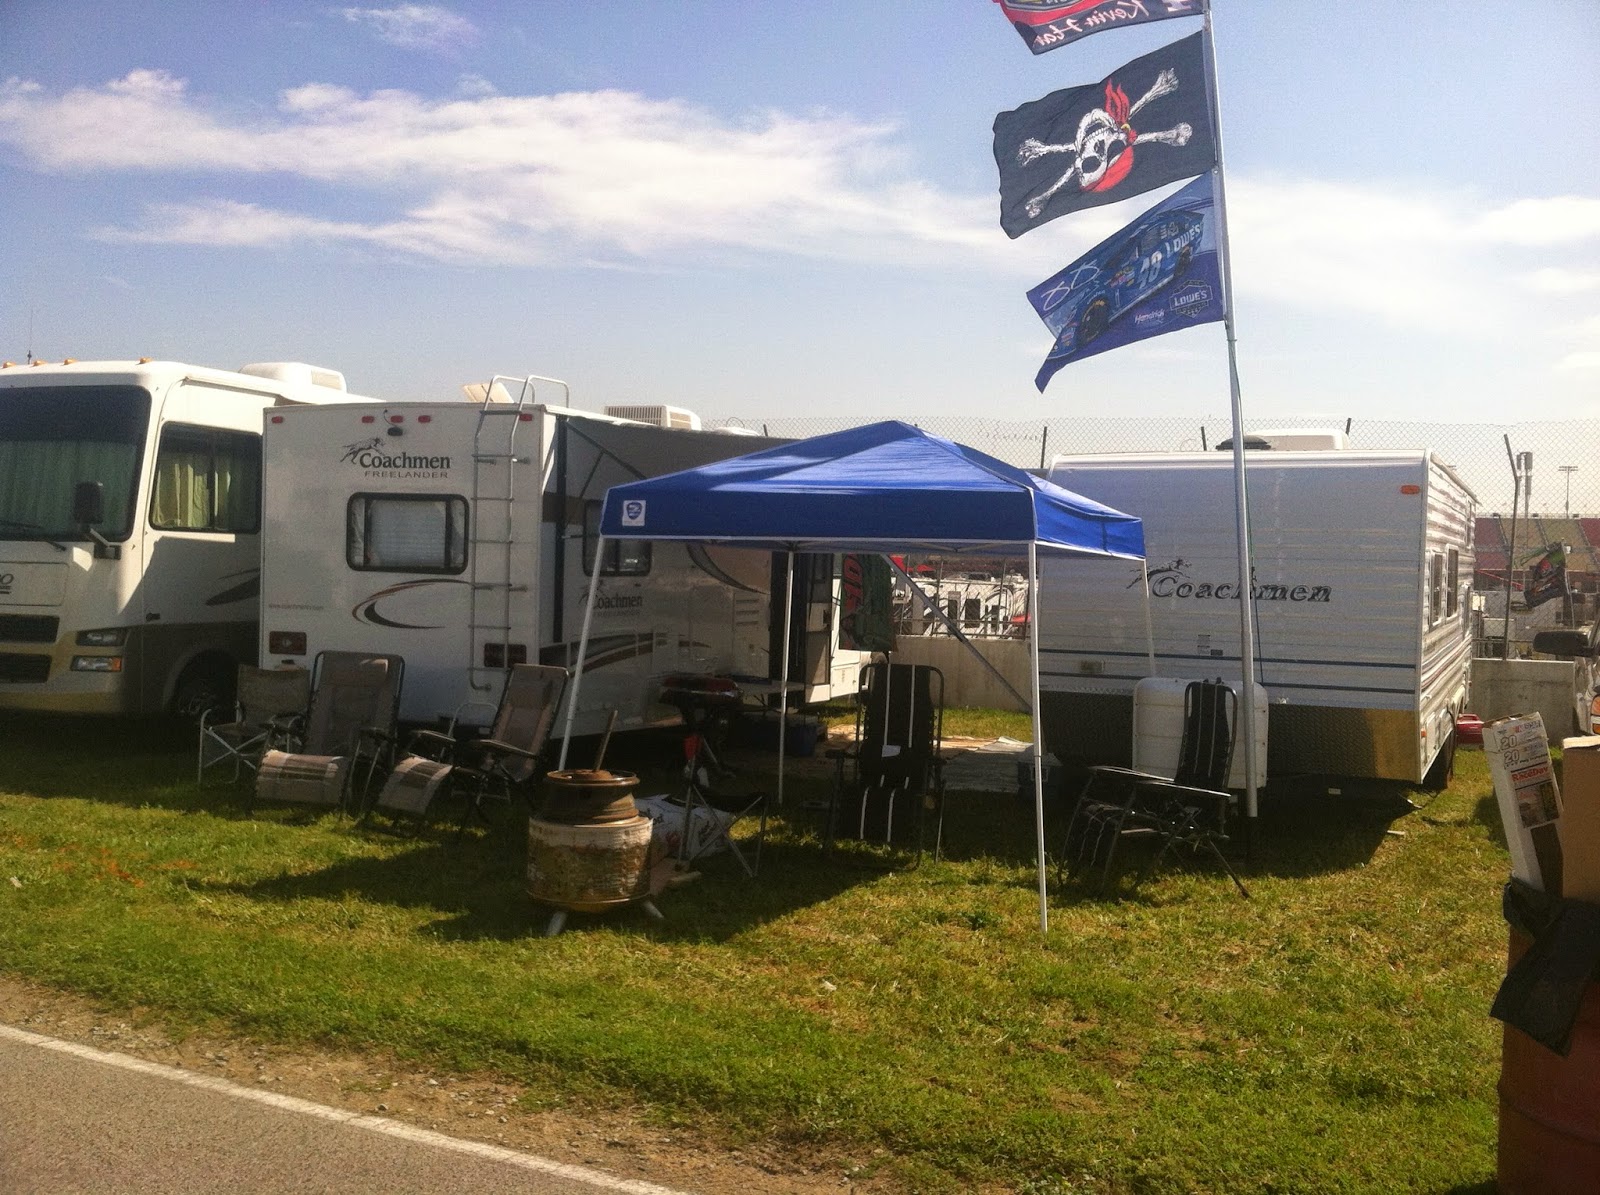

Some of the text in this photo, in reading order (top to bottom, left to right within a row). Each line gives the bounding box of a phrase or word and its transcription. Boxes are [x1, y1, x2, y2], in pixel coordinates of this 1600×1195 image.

[1165, 224, 1201, 258] LOWE'S
[1174, 289, 1208, 307] LOWE'S
[360, 451, 451, 469] Coachmen
[364, 470, 449, 479] FREELANDER
[1511, 767, 1549, 783] RaceDay
